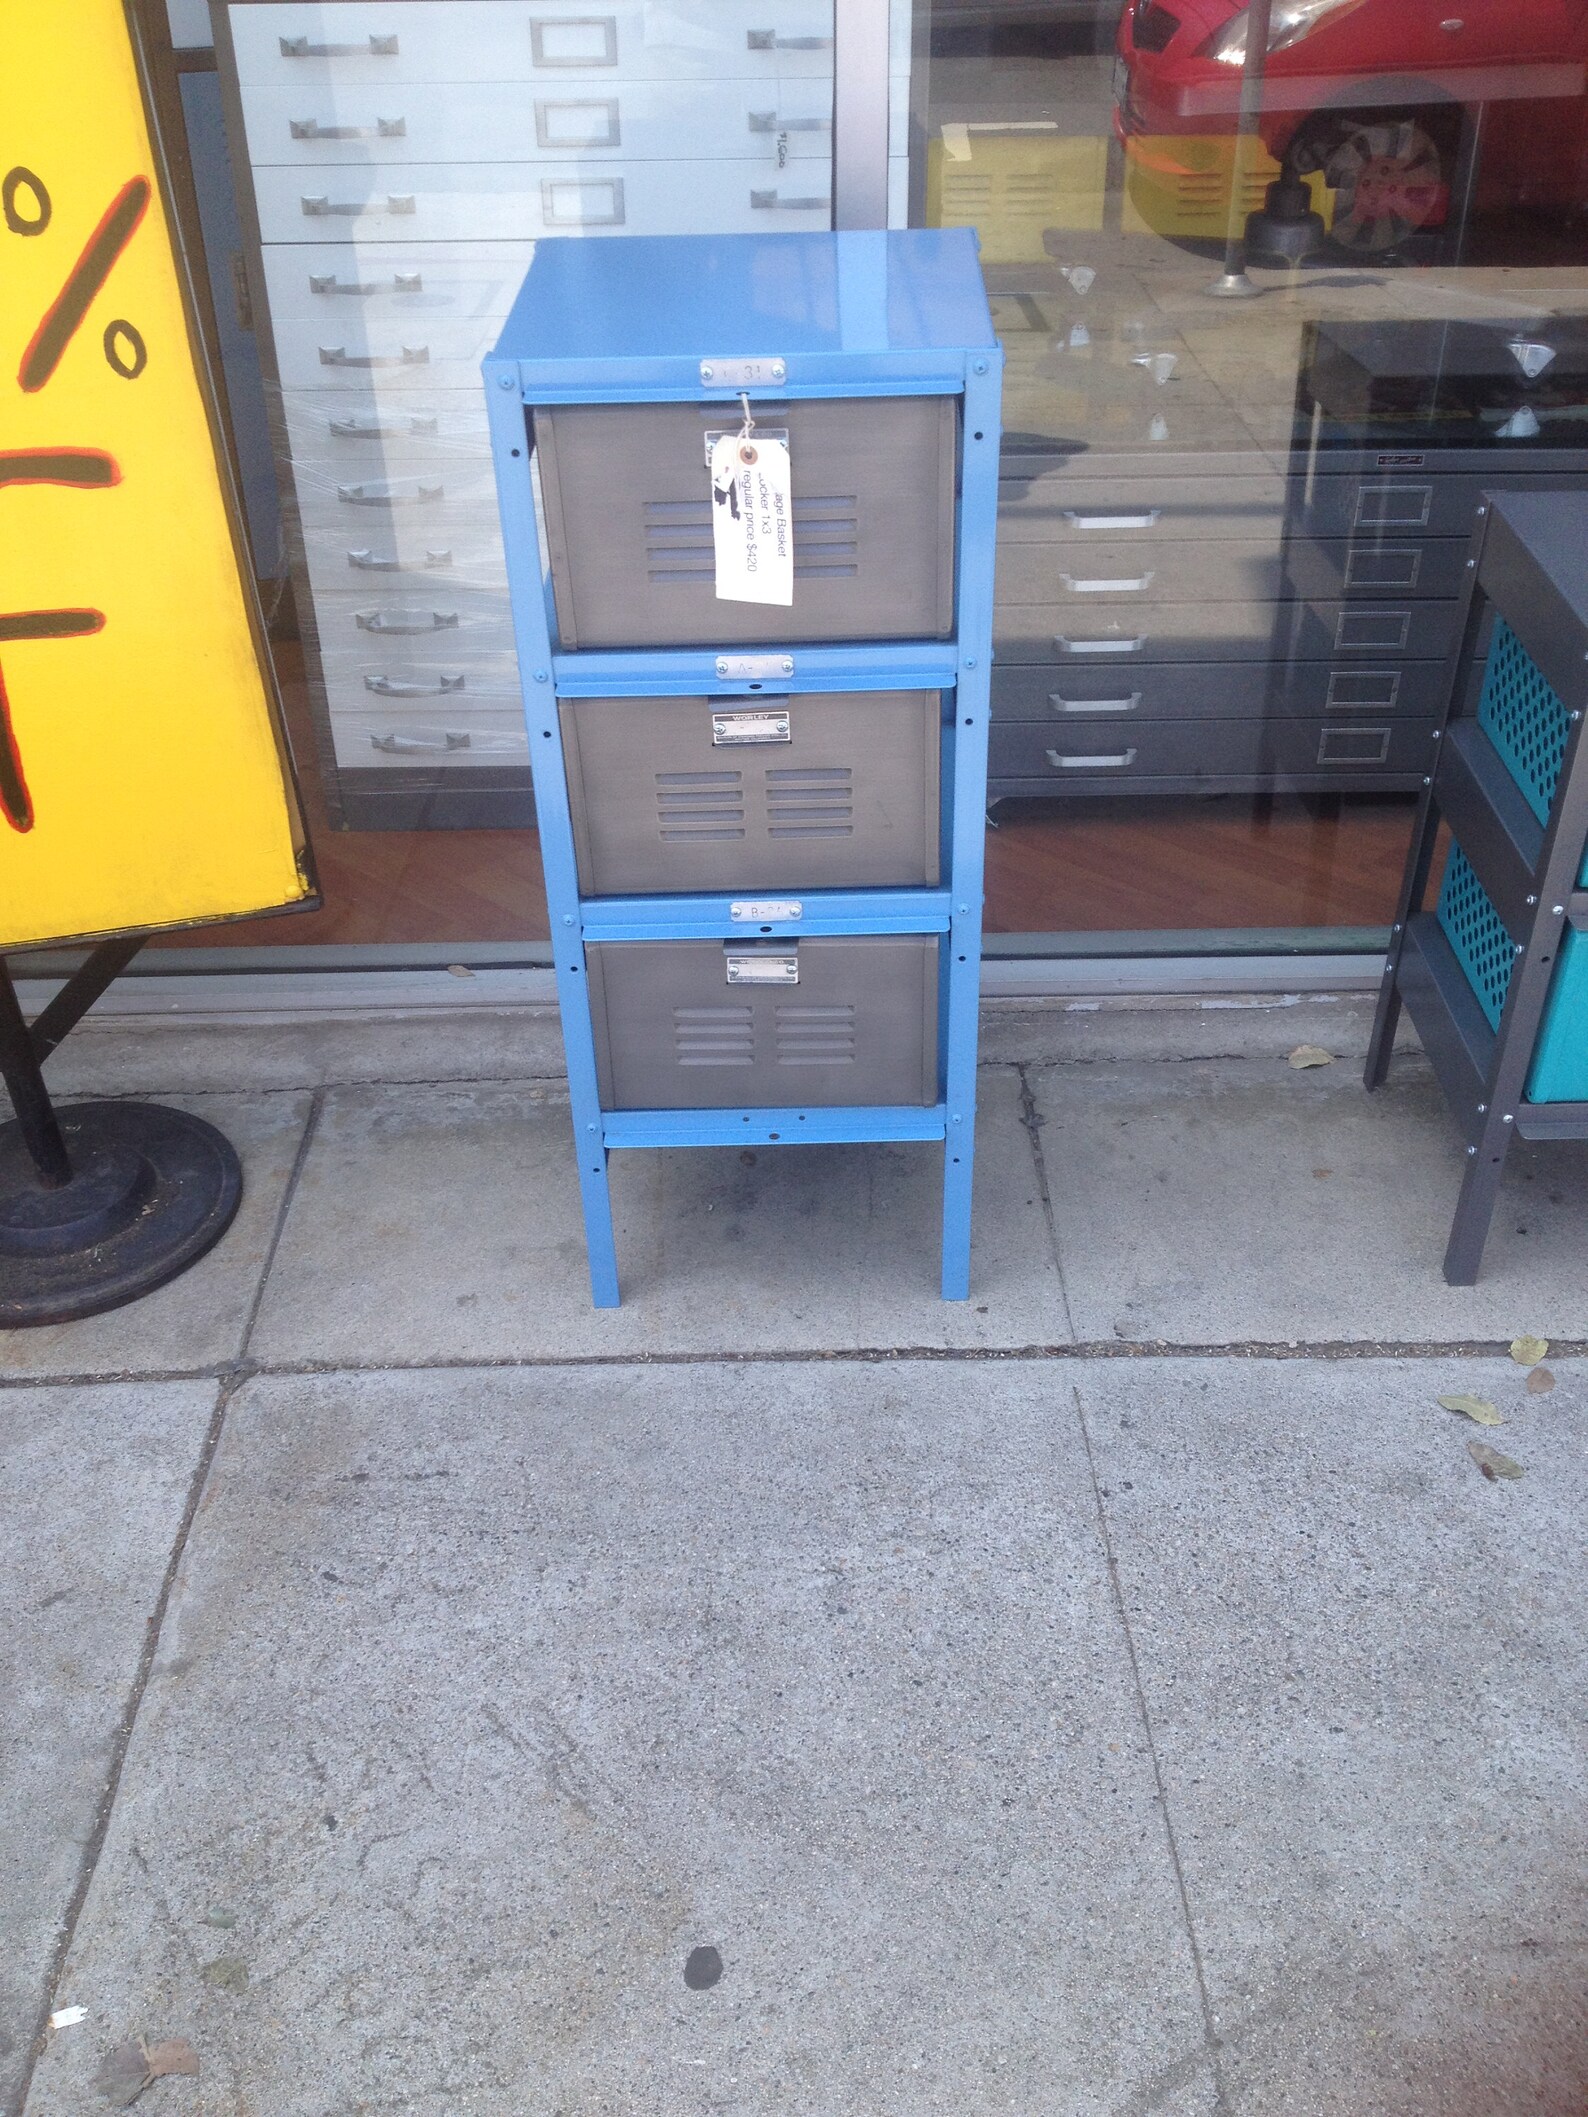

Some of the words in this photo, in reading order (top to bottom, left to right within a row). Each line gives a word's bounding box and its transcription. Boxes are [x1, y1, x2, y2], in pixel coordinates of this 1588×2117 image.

[741, 470, 754, 509] regular
[758, 472, 770, 510] ocker
[743, 512, 756, 540] price
[761, 515, 772, 535] 1x3
[777, 518, 787, 557] Basket
[746, 543, 758, 572] $420
